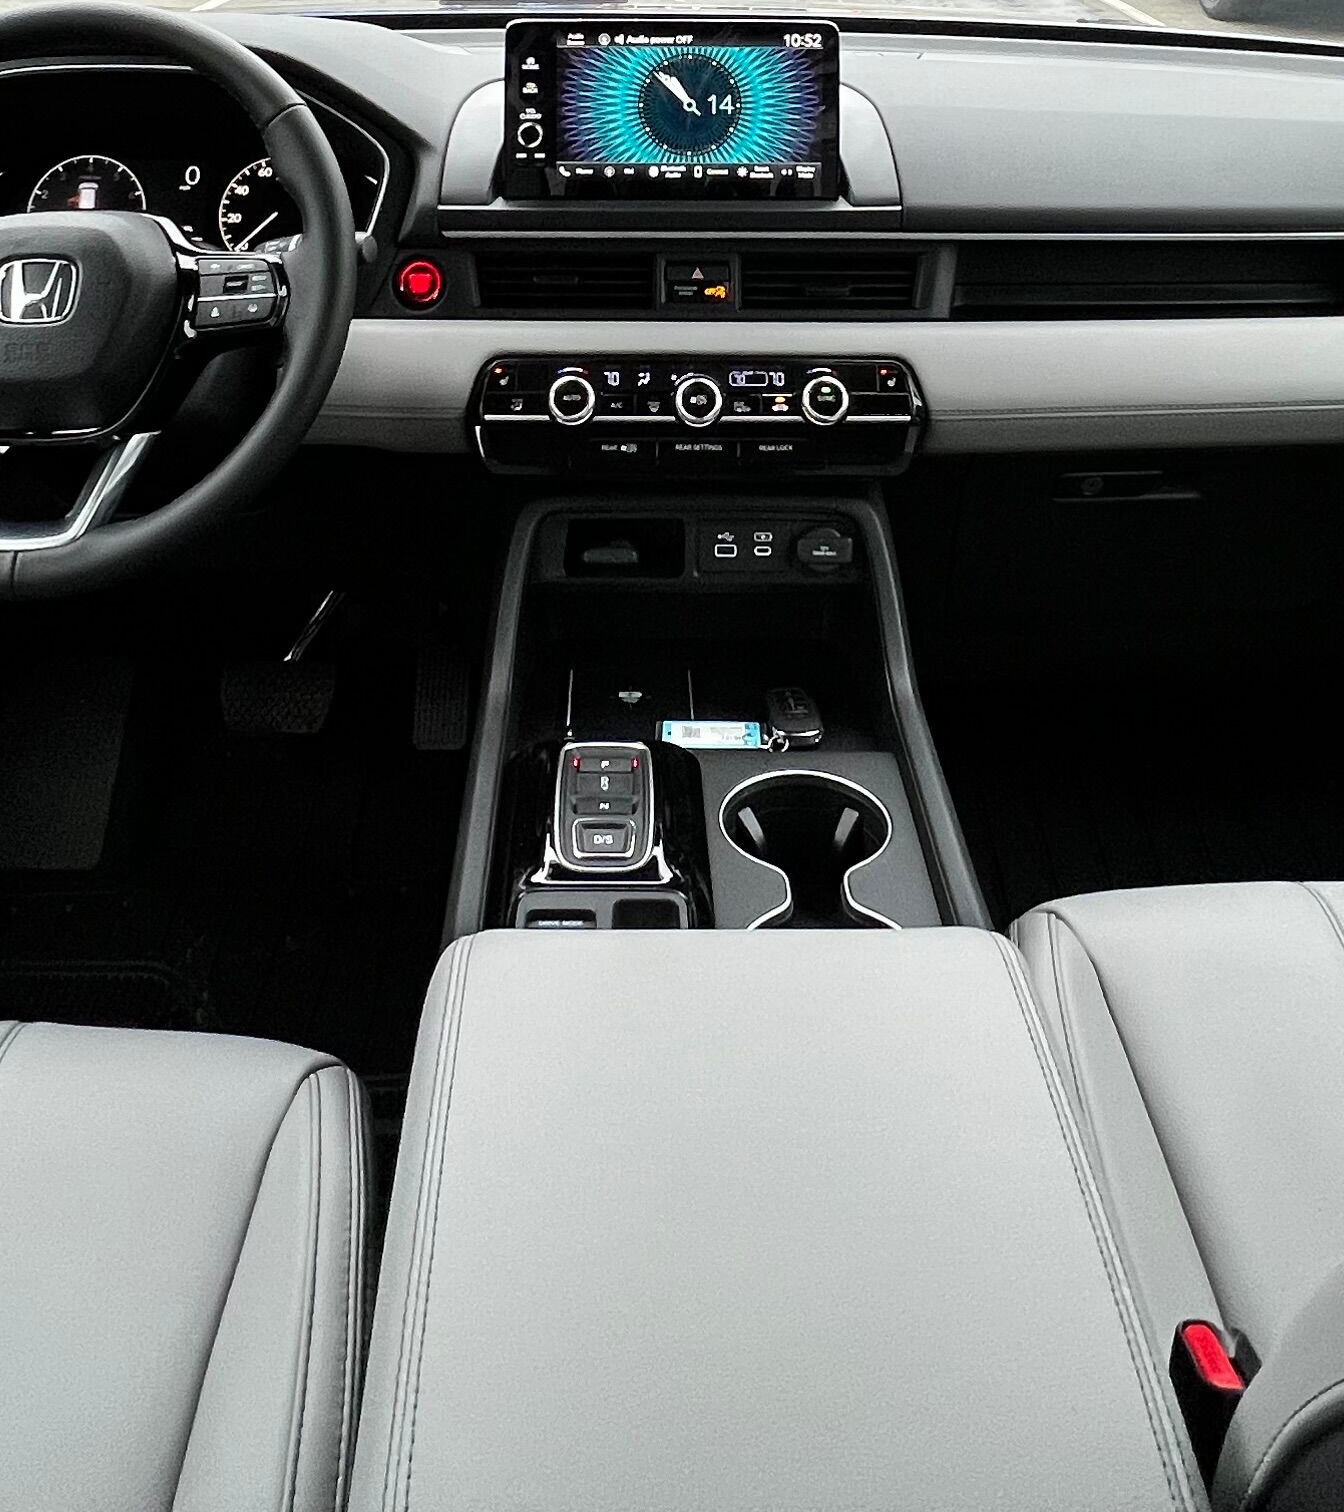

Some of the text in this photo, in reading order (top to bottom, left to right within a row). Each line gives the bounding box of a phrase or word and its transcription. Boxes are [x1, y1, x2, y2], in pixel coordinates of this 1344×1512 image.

[675, 34, 694, 44] OFF
[783, 33, 823, 48] 10:52
[706, 95, 734, 114] 14
[185, 165, 201, 186] 0
[257, 167, 273, 178] 60
[227, 213, 242, 223] 20
[604, 371, 620, 386] 70
[769, 371, 785, 387] 70
[593, 834, 614, 845] D/S
